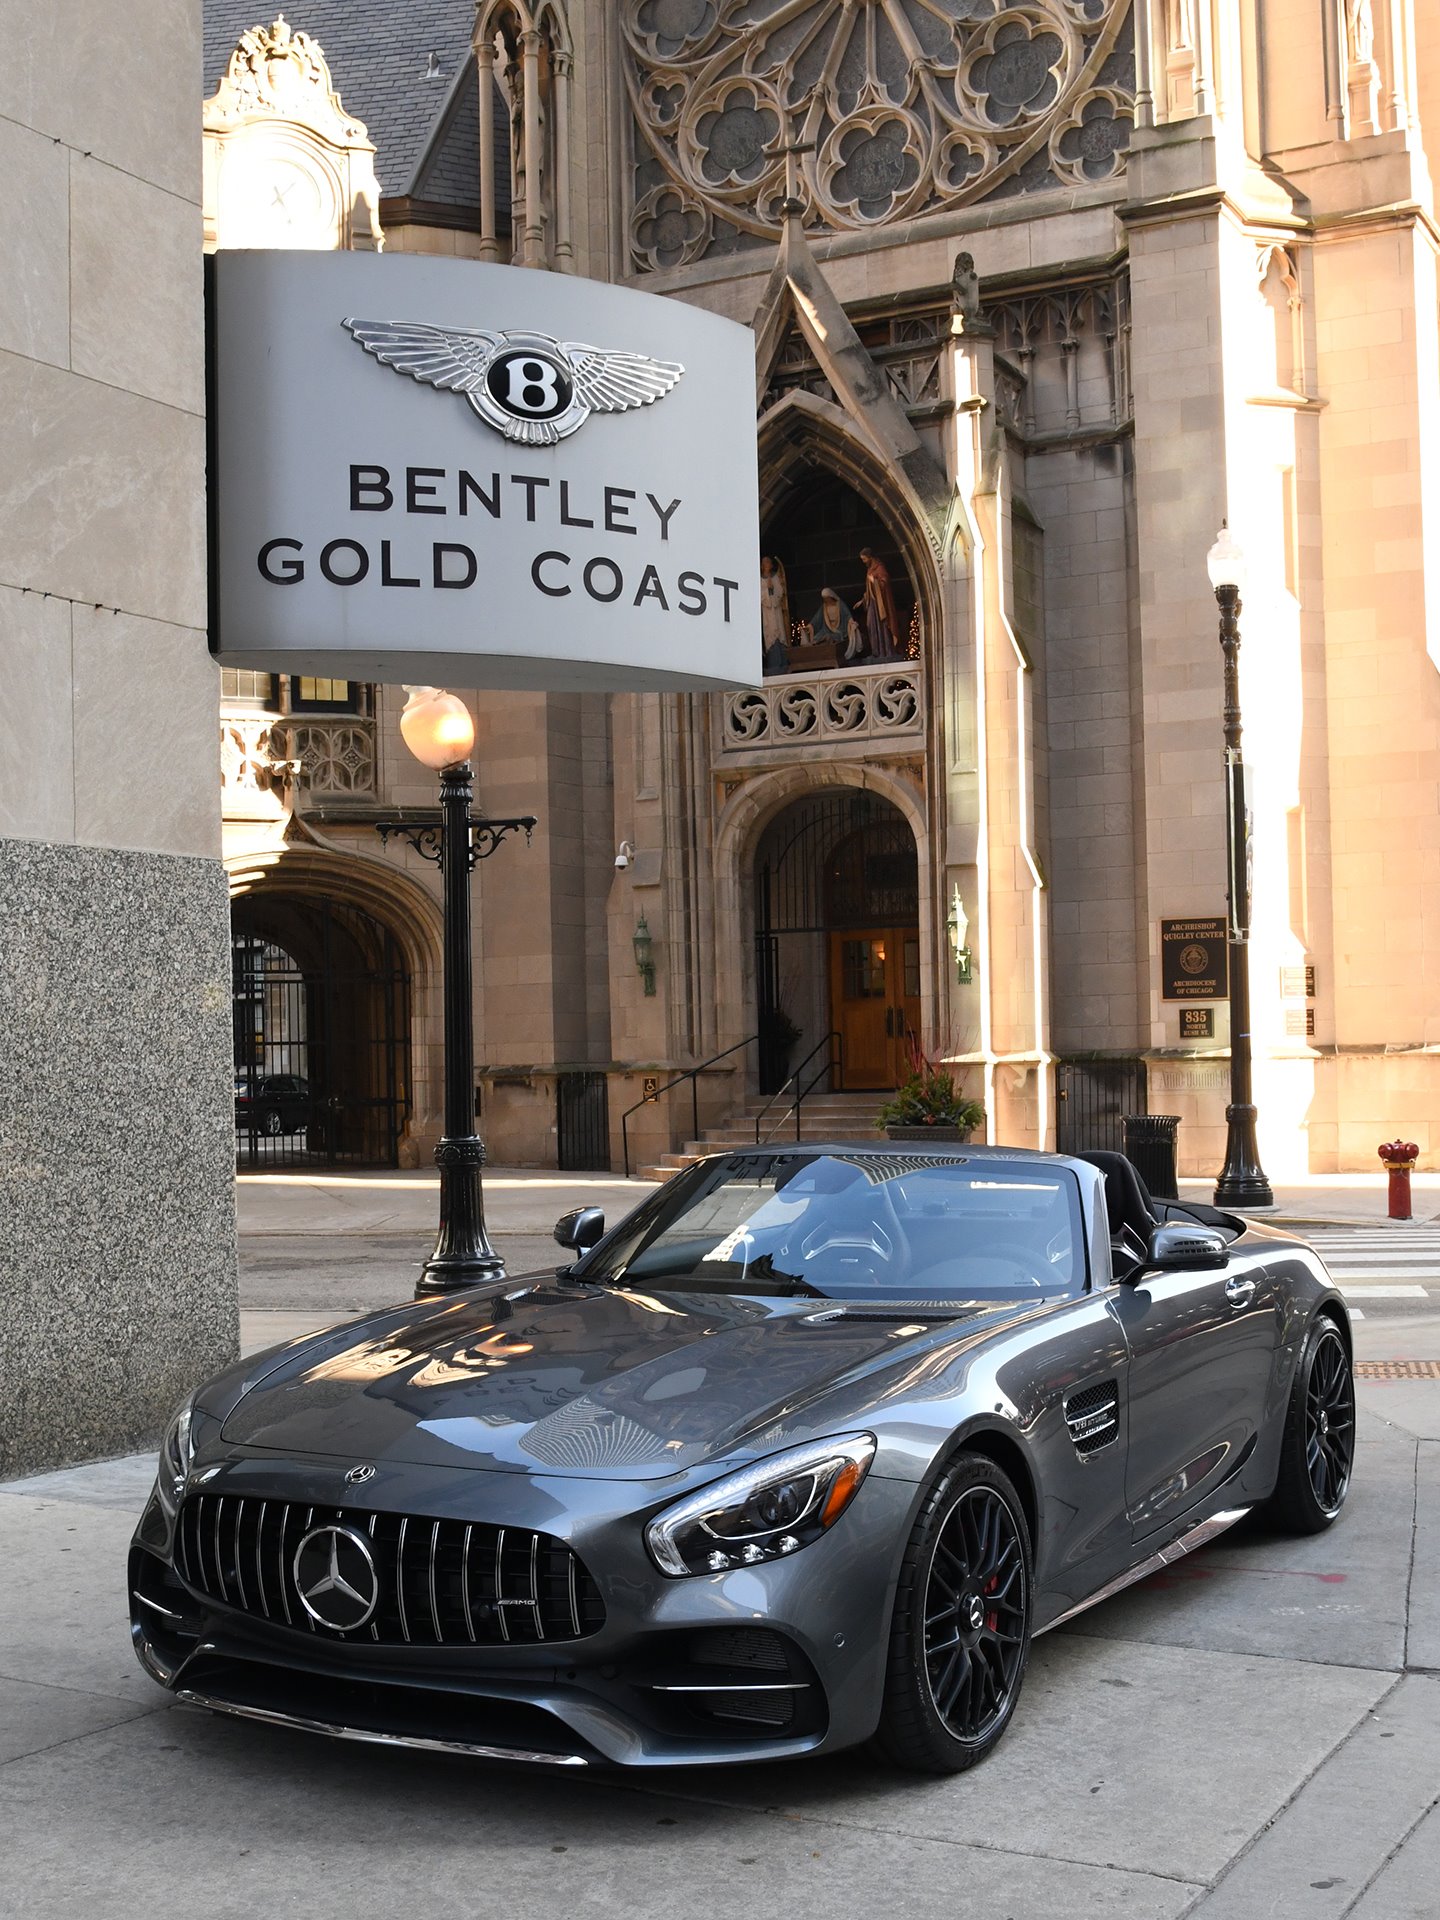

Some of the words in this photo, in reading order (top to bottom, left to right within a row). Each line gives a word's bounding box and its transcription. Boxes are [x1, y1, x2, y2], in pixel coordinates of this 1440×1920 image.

[506, 357, 559, 413] B
[349, 464, 682, 541] BENTLEY
[257, 537, 478, 590] GOLD
[530, 550, 740, 623] COAST
[1163, 932, 1195, 941] QUIGLEY
[1195, 931, 1224, 939] CENTER
[1170, 923, 1216, 931] ARCHBISHOP
[1185, 1010, 1207, 1023] 835
